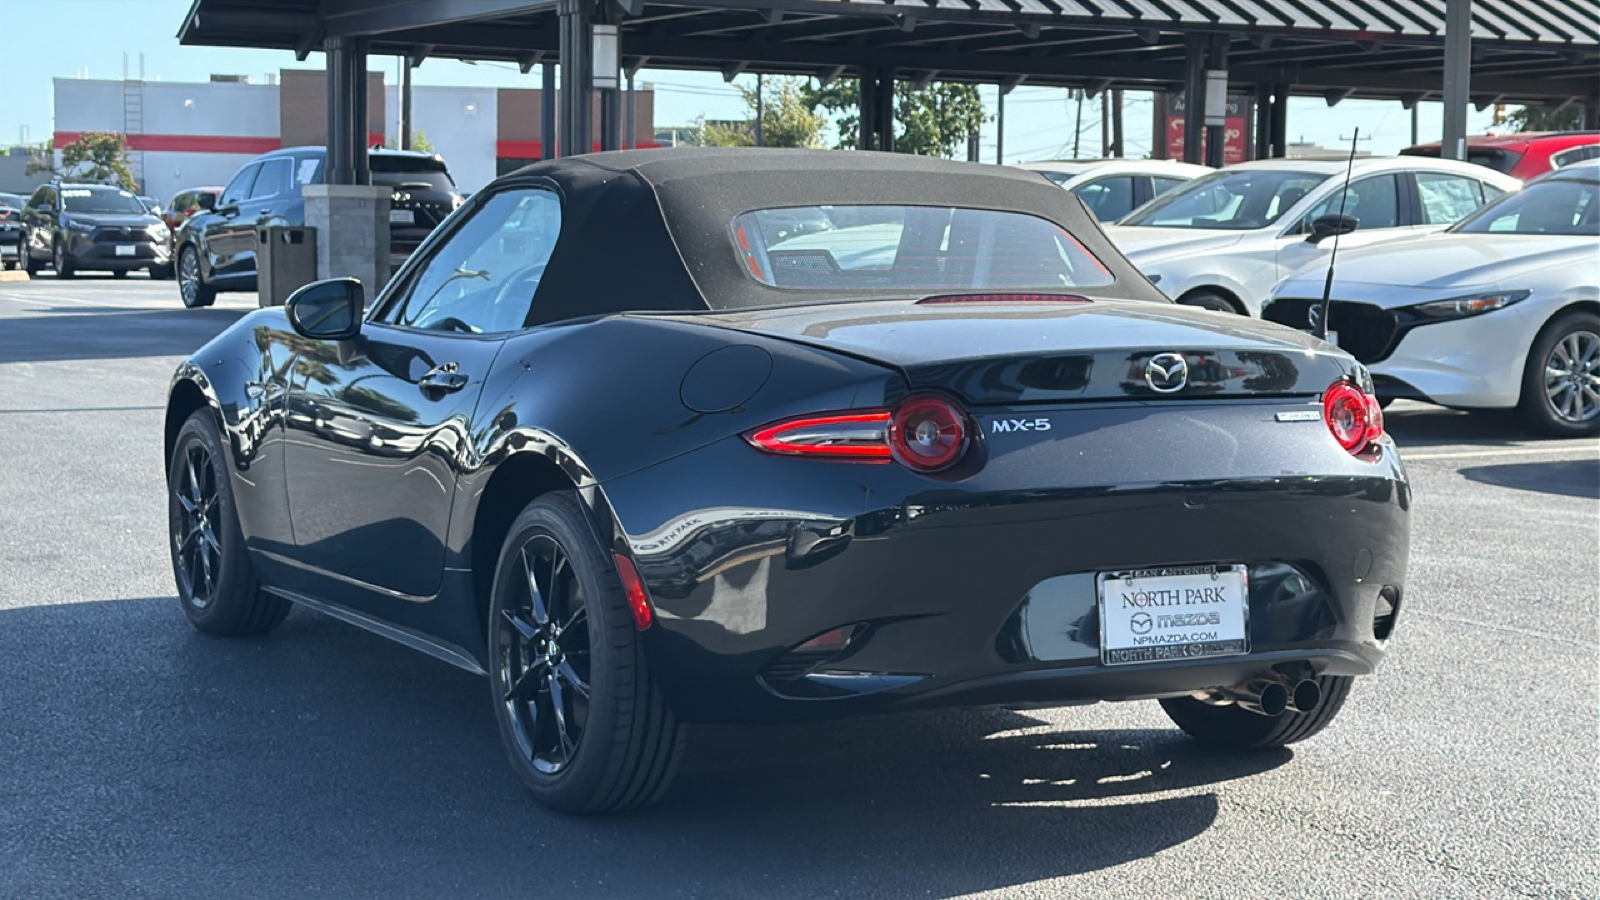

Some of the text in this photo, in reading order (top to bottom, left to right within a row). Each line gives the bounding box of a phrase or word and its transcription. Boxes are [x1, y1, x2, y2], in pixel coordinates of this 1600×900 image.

[992, 418, 1050, 433] MX-5
[1135, 566, 1211, 578] SAN ANTONIO
[1121, 587, 1226, 609] NORTH PARK
[1133, 632, 1218, 645] NPMAZDA.COM
[1111, 648, 1152, 662] NORTH
[1155, 645, 1188, 659] PARK
